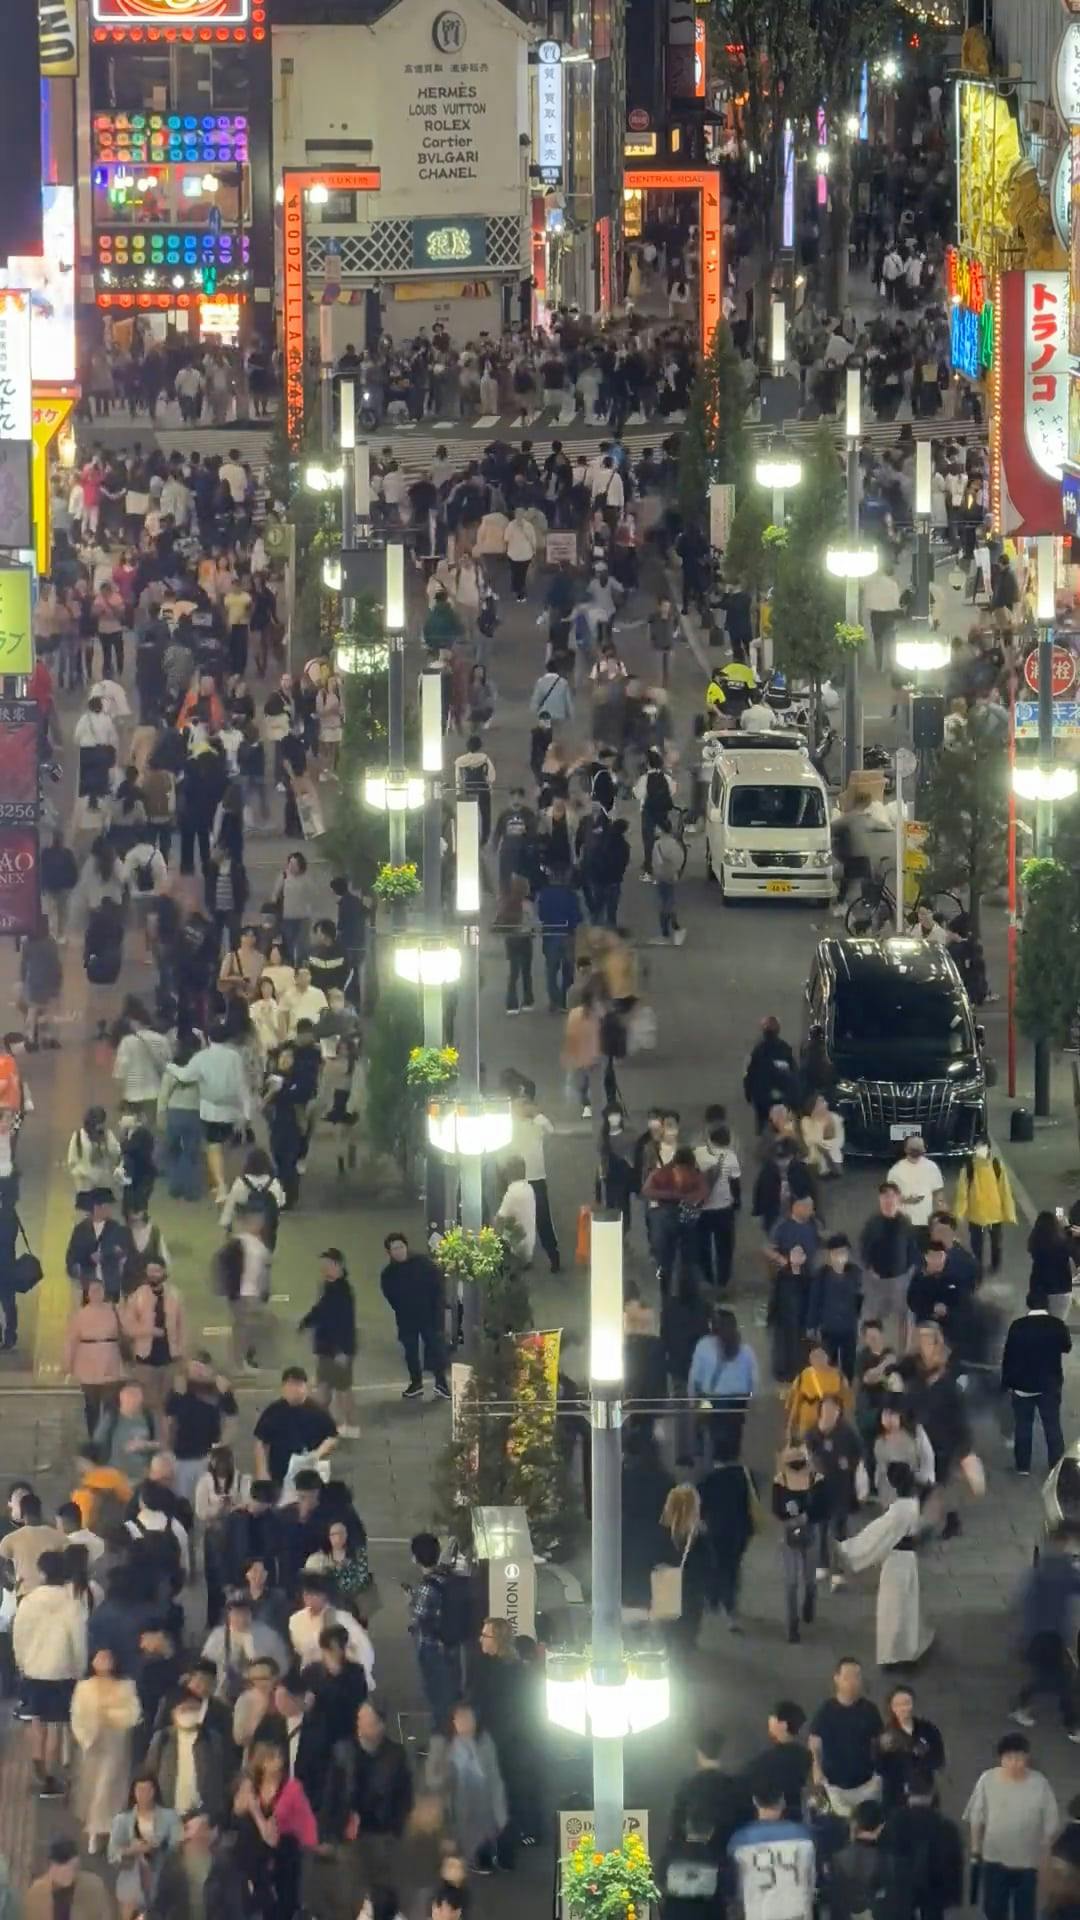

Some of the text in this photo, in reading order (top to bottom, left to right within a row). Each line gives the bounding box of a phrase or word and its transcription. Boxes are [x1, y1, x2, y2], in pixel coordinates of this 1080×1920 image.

[408, 103, 486, 116] LOUIS VUITTON
[424, 119, 471, 132] ROLEX
[422, 135, 473, 150] Cartier
[417, 151, 479, 165] BVLGARI
[418, 167, 477, 180] CHANEL
[629, 175, 675, 183] CENTRAL
[288, 213, 302, 340] GODZILLA
[1031, 283, 1057, 402] トラノコ
[1030, 660, 1071, 680] 消栓
[753, 1848, 800, 1890] 94
